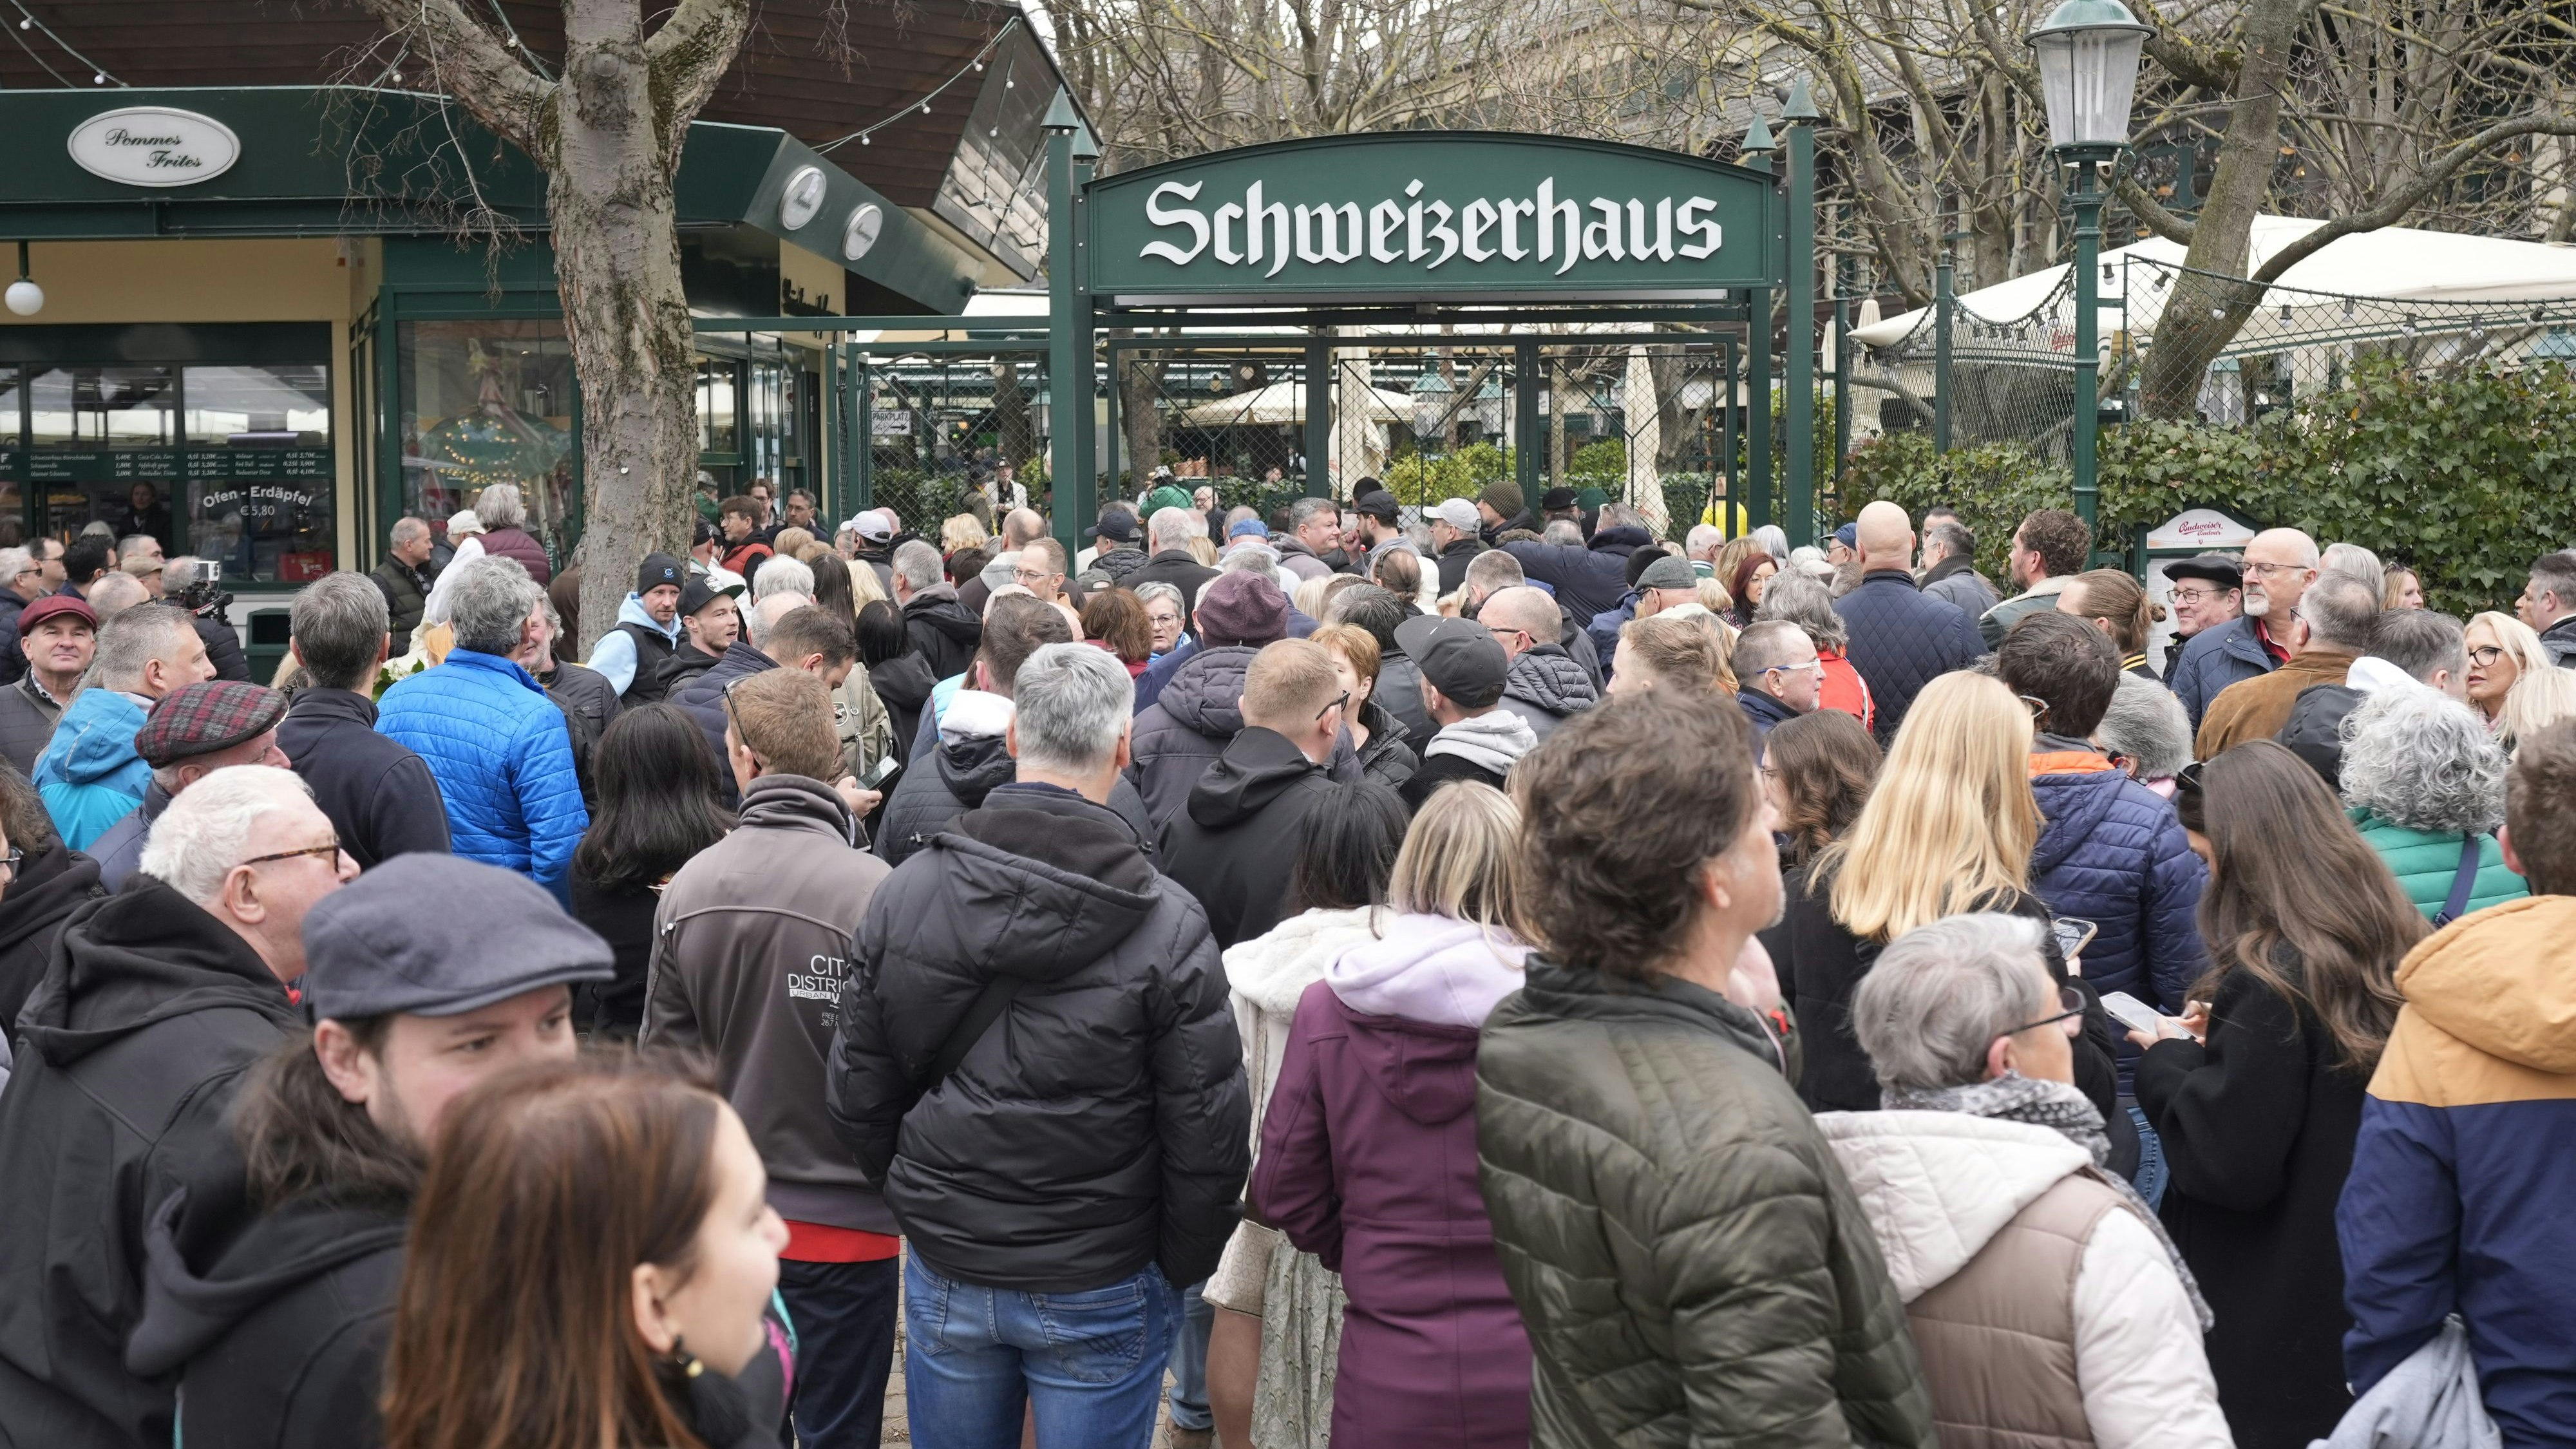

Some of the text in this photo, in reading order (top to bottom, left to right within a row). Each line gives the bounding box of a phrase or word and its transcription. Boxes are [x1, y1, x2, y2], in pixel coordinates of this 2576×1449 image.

[105, 129, 182, 146] Pommes
[146, 150, 202, 168] Frites
[1140, 176, 1722, 278] Schweizerhaus
[203, 489, 238, 507] Ofen
[251, 486, 312, 507] Erdäpfel
[2179, 521, 2222, 535] Budweiser
[196, 603, 214, 615] RONIN
[811, 955, 850, 977] CIT
[792, 990, 827, 999] URBAN
